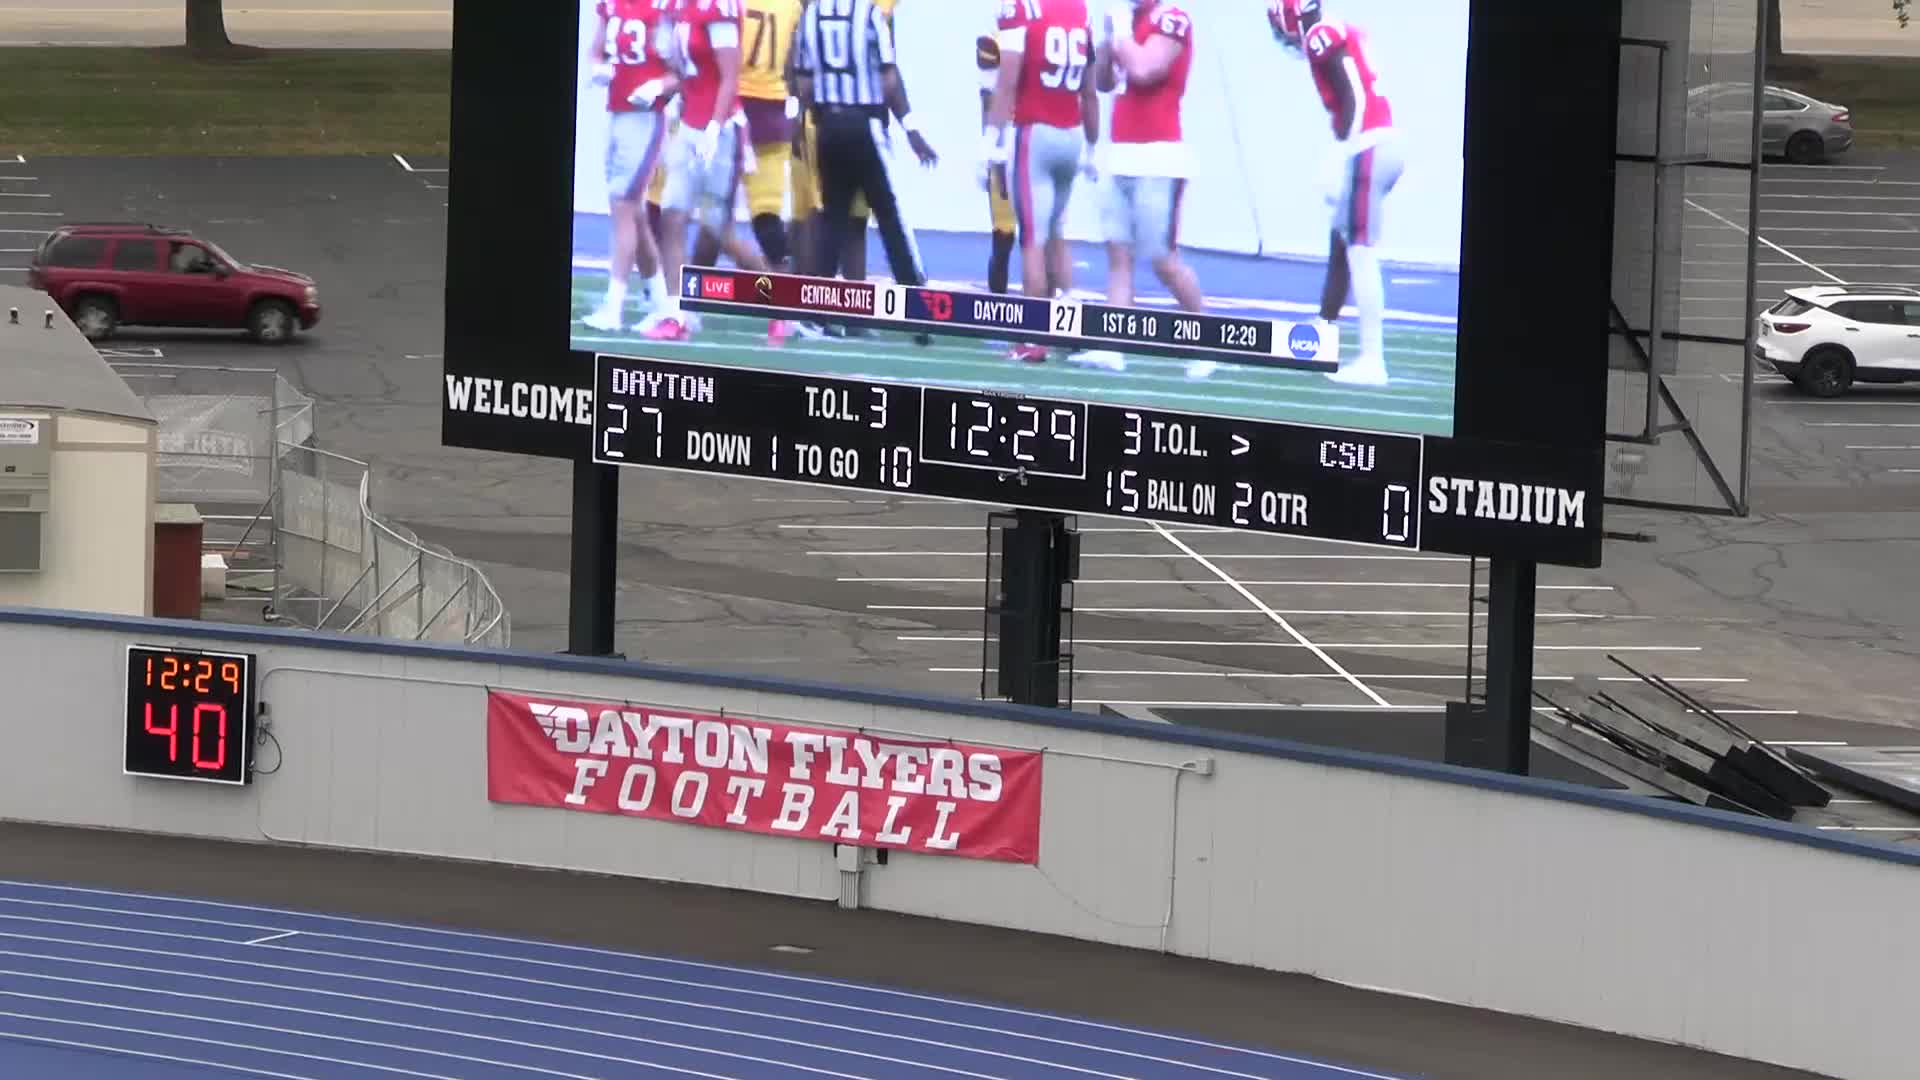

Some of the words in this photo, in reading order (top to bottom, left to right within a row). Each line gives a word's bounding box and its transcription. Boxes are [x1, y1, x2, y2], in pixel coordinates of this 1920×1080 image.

[705, 281, 730, 294] LIVE
[801, 284, 842, 307] CENTRAL
[844, 287, 873, 310] STATE
[884, 289, 895, 315] 0
[974, 300, 1023, 324] DAYTON
[1055, 306, 1076, 333] 27
[1102, 313, 1125, 333] 1ST
[1127, 314, 1136, 334] &
[1142, 316, 1156, 336] 10
[1174, 319, 1200, 341] 2ND
[446, 374, 593, 426] WELCOME
[612, 368, 715, 403] DAYTON
[805, 386, 860, 422] T.O.L.
[869, 387, 888, 429] 3
[603, 404, 662, 458] 27
[687, 431, 751, 466] DOWN
[771, 435, 778, 472] 1
[795, 443, 822, 477] TO
[829, 447, 859, 480] GO
[879, 447, 912, 488] 10
[950, 400, 1076, 463] 12:29
[1123, 412, 1142, 456] 3
[1151, 421, 1208, 457] T.O.L.
[1320, 440, 1376, 471] CSU
[1106, 470, 1139, 512] 15
[1147, 479, 1188, 514] BALL
[1191, 484, 1216, 516] ON
[1232, 482, 1252, 525] 2
[1260, 490, 1308, 526] QTR
[1382, 484, 1410, 542] 0
[1428, 476, 1585, 528] STADIUM
[146, 656, 239, 695] 12:29
[144, 702, 227, 770] 40
[528, 702, 771, 774] DAYTON
[785, 730, 1003, 801] FLYERS
[565, 758, 960, 849] FOOTBALL
